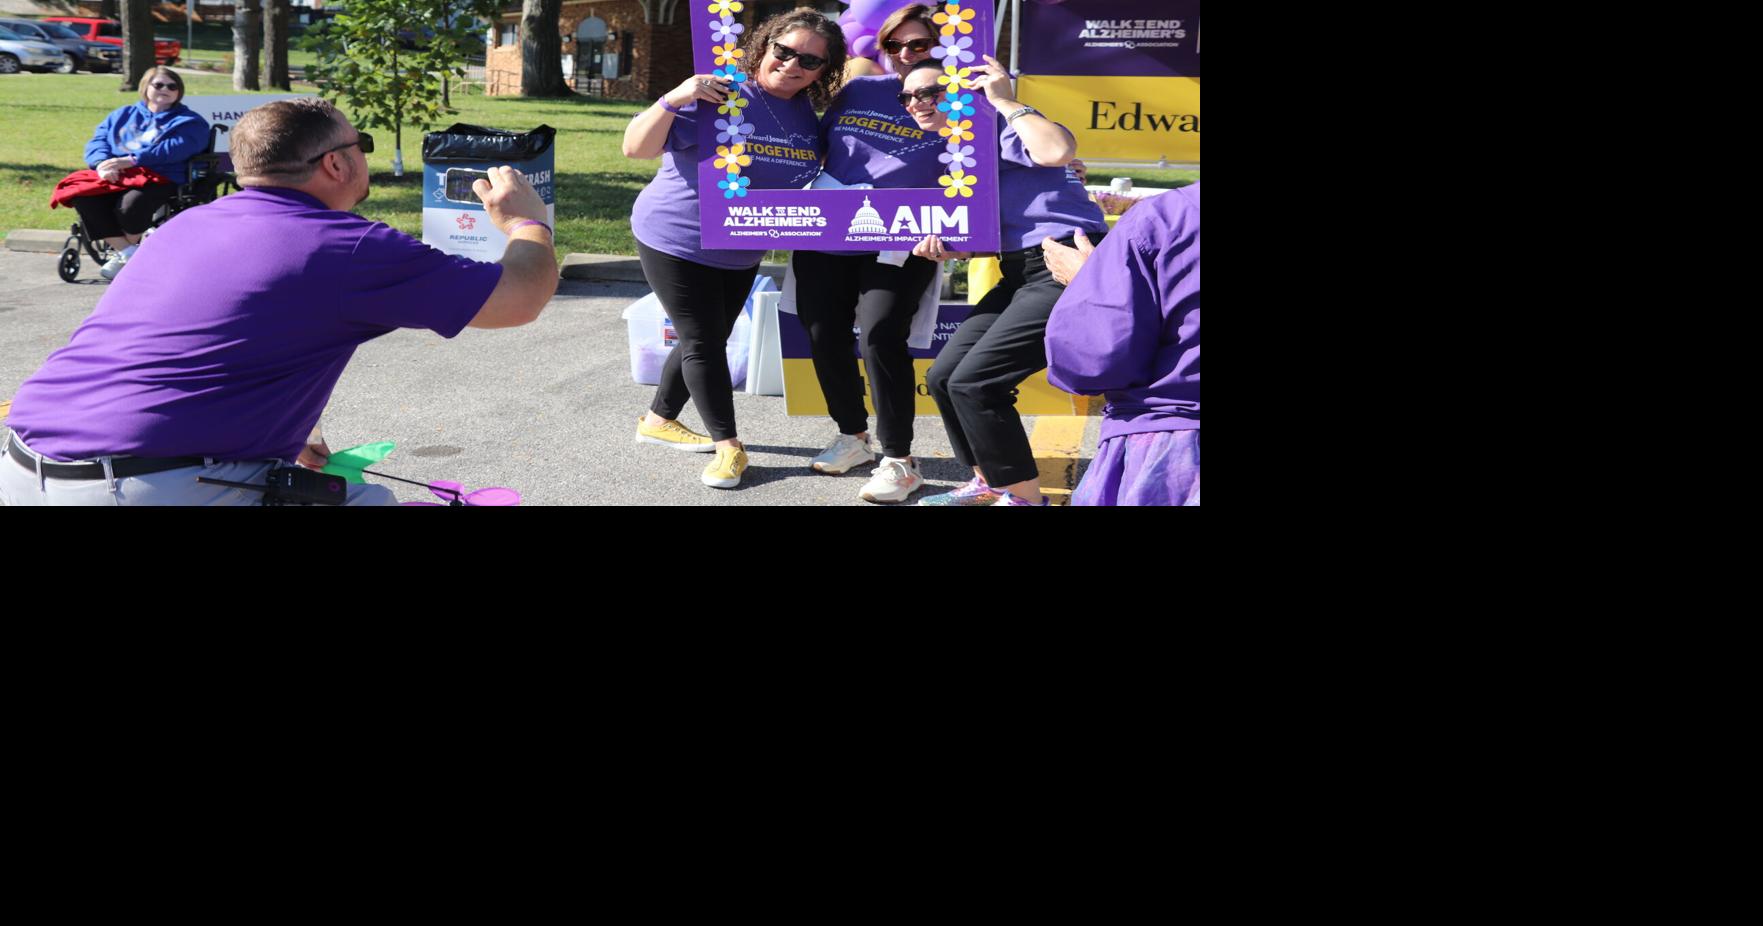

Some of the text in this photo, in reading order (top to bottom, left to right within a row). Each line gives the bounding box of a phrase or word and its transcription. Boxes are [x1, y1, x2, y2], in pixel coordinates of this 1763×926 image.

[1085, 20, 1132, 29] WALK
[1146, 20, 1180, 29] END
[1079, 30, 1186, 38] ALZHEIMER'S
[838, 116, 924, 139] TOGETHER
[745, 142, 816, 160] TOGETHER
[728, 206, 774, 216] WALK
[787, 206, 821, 216] END
[723, 217, 827, 227] ALZHEIMER'S
[889, 205, 969, 234] AIM
